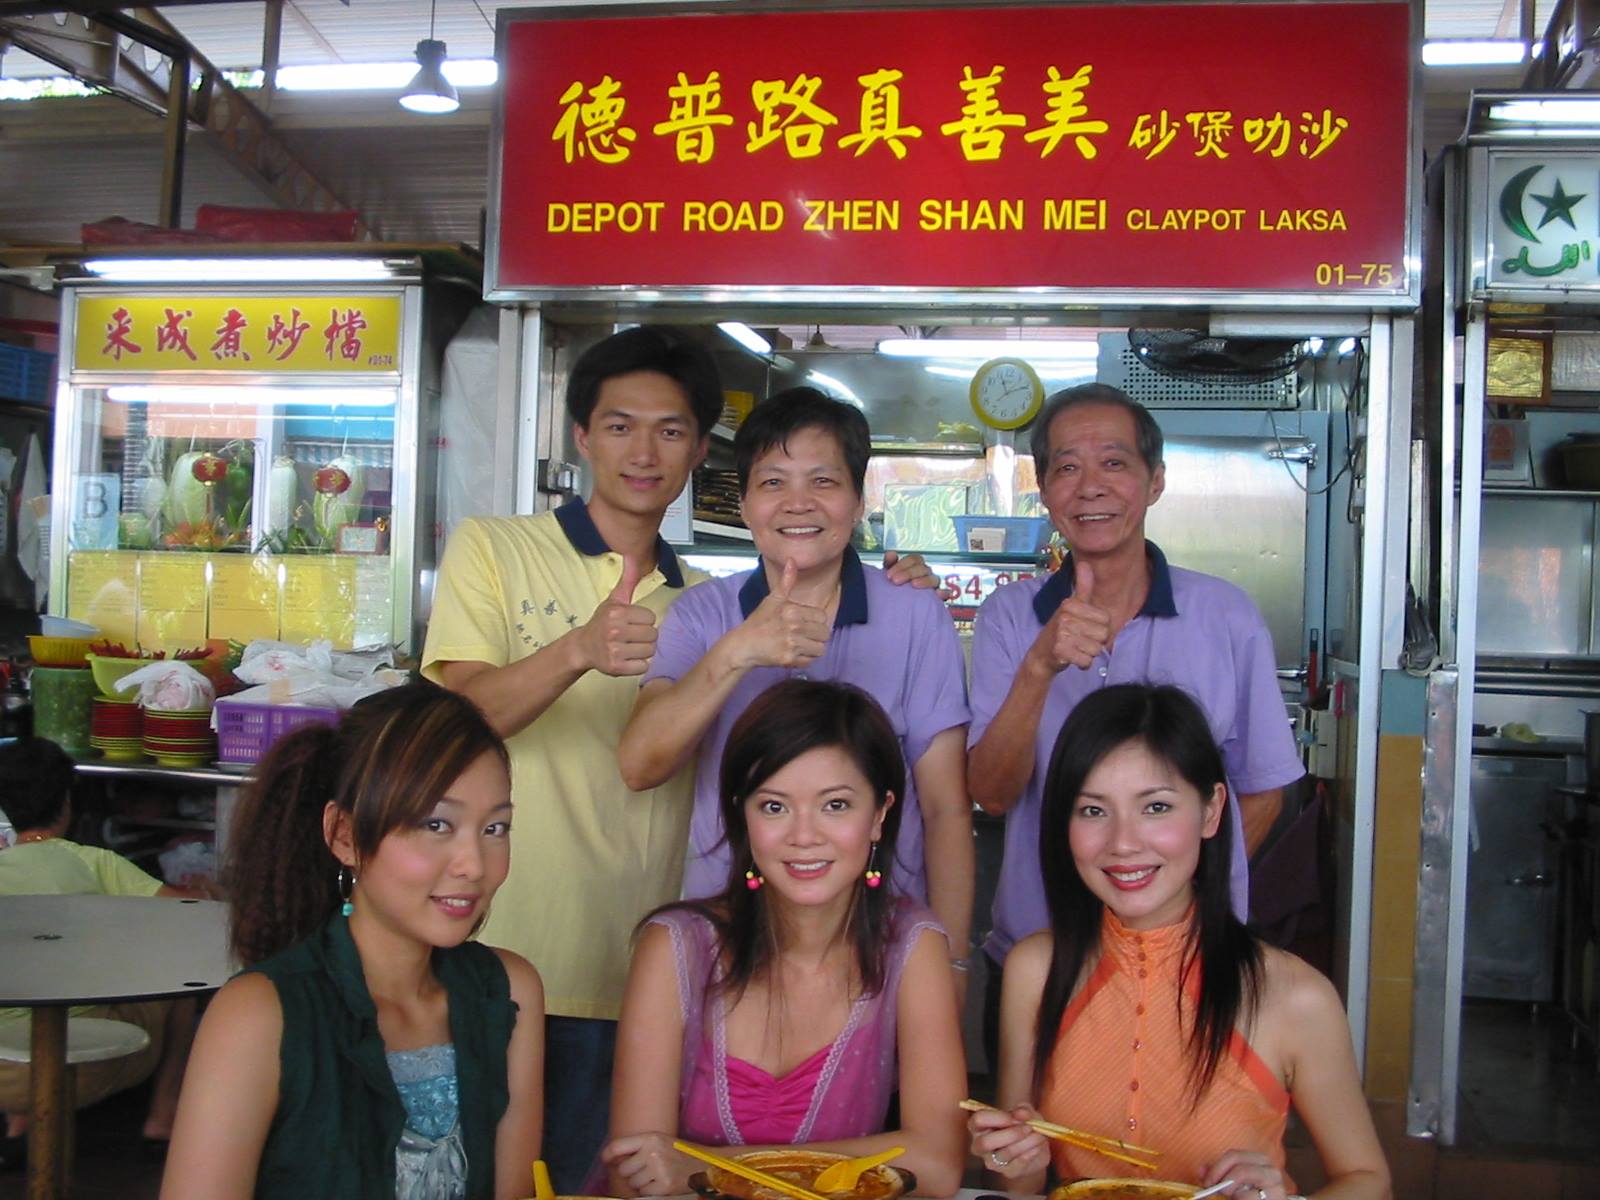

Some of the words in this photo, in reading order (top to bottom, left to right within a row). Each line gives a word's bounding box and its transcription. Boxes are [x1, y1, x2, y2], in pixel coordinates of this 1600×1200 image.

[551, 65, 1109, 164] 德普路真善美
[547, 201, 665, 233] DEPOT
[682, 200, 785, 232] ROAD
[802, 199, 900, 232] ZHEN
[919, 199, 1024, 232] SHAN
[1043, 199, 1107, 231] MEI
[1126, 209, 1246, 231] CLAYPOT
[1259, 209, 1347, 231] LAKSA
[83, 482, 108, 519] B
